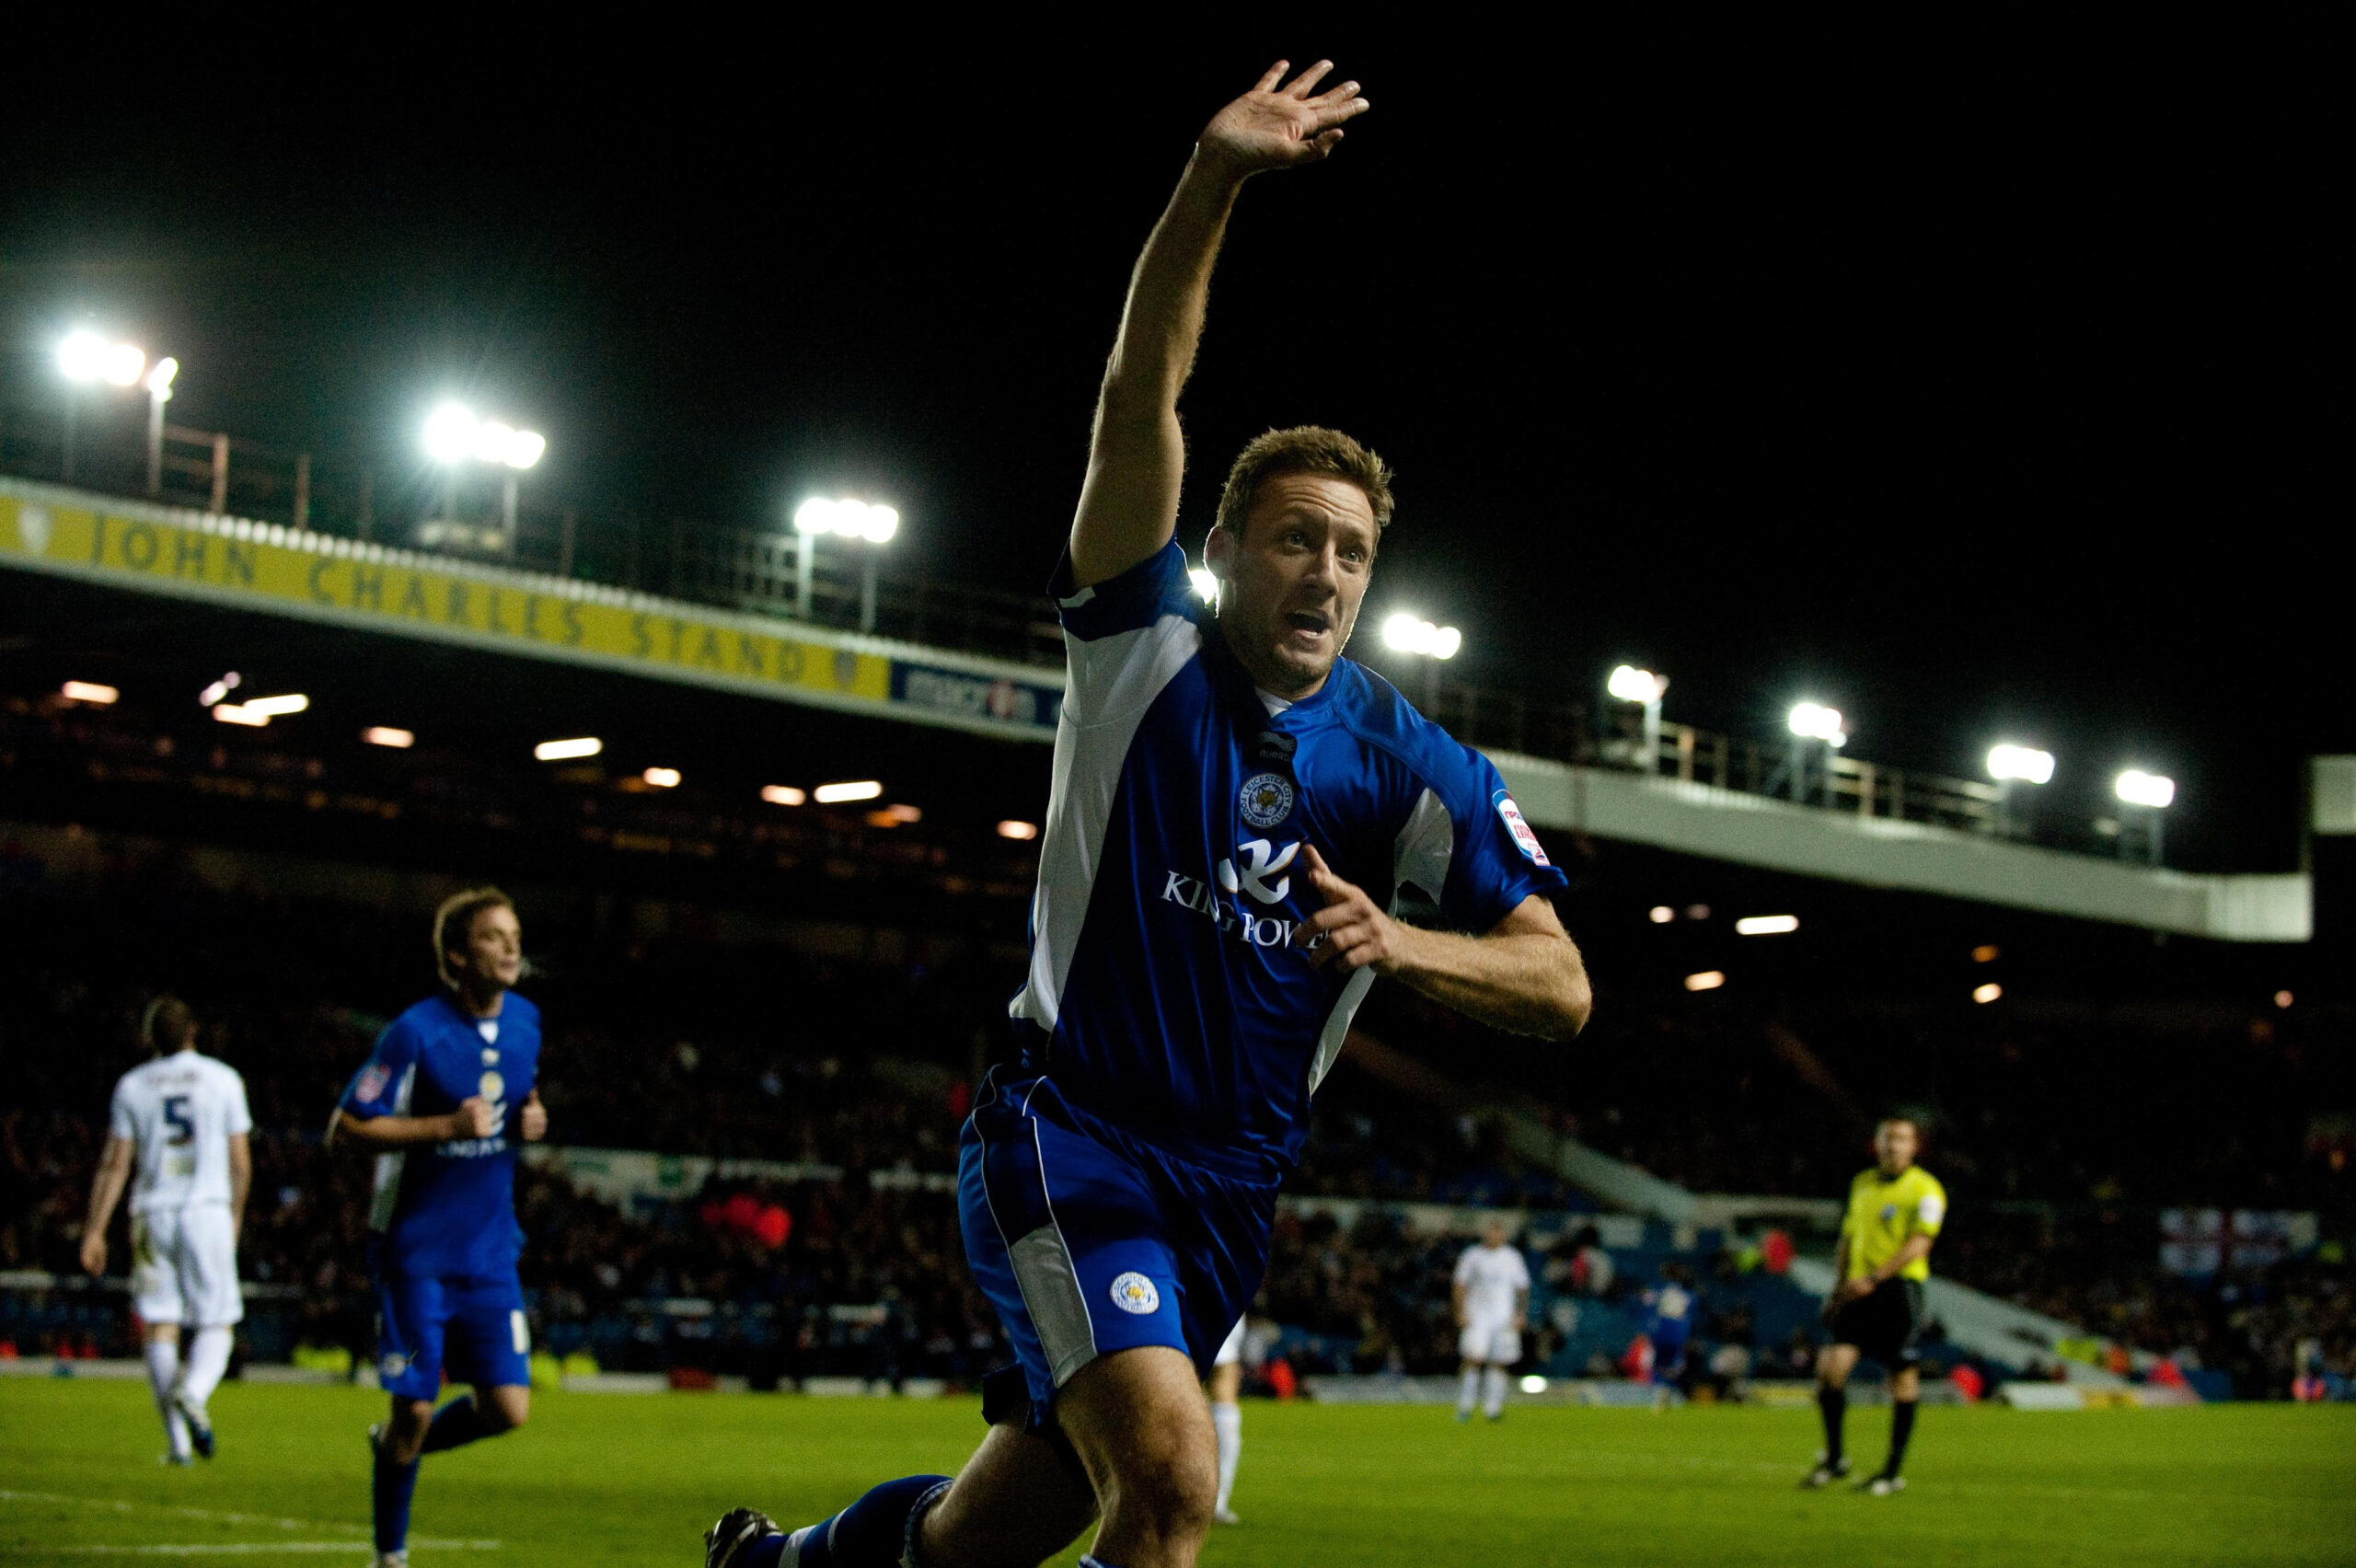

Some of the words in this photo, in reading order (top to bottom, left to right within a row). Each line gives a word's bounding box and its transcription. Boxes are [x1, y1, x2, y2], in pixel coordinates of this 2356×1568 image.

[93, 513, 255, 588] JOHN
[307, 555, 583, 644] CHARLES
[631, 616, 805, 684] STAND
[1241, 797, 1271, 825] FOOTBALL
[1270, 806, 1289, 824] CLUB
[1243, 774, 1285, 795] LEICESTER
[1282, 785, 1291, 803] CITY
[1161, 870, 1235, 932] KING
[1240, 912, 1330, 950] POW
[163, 1095, 196, 1146] 5
